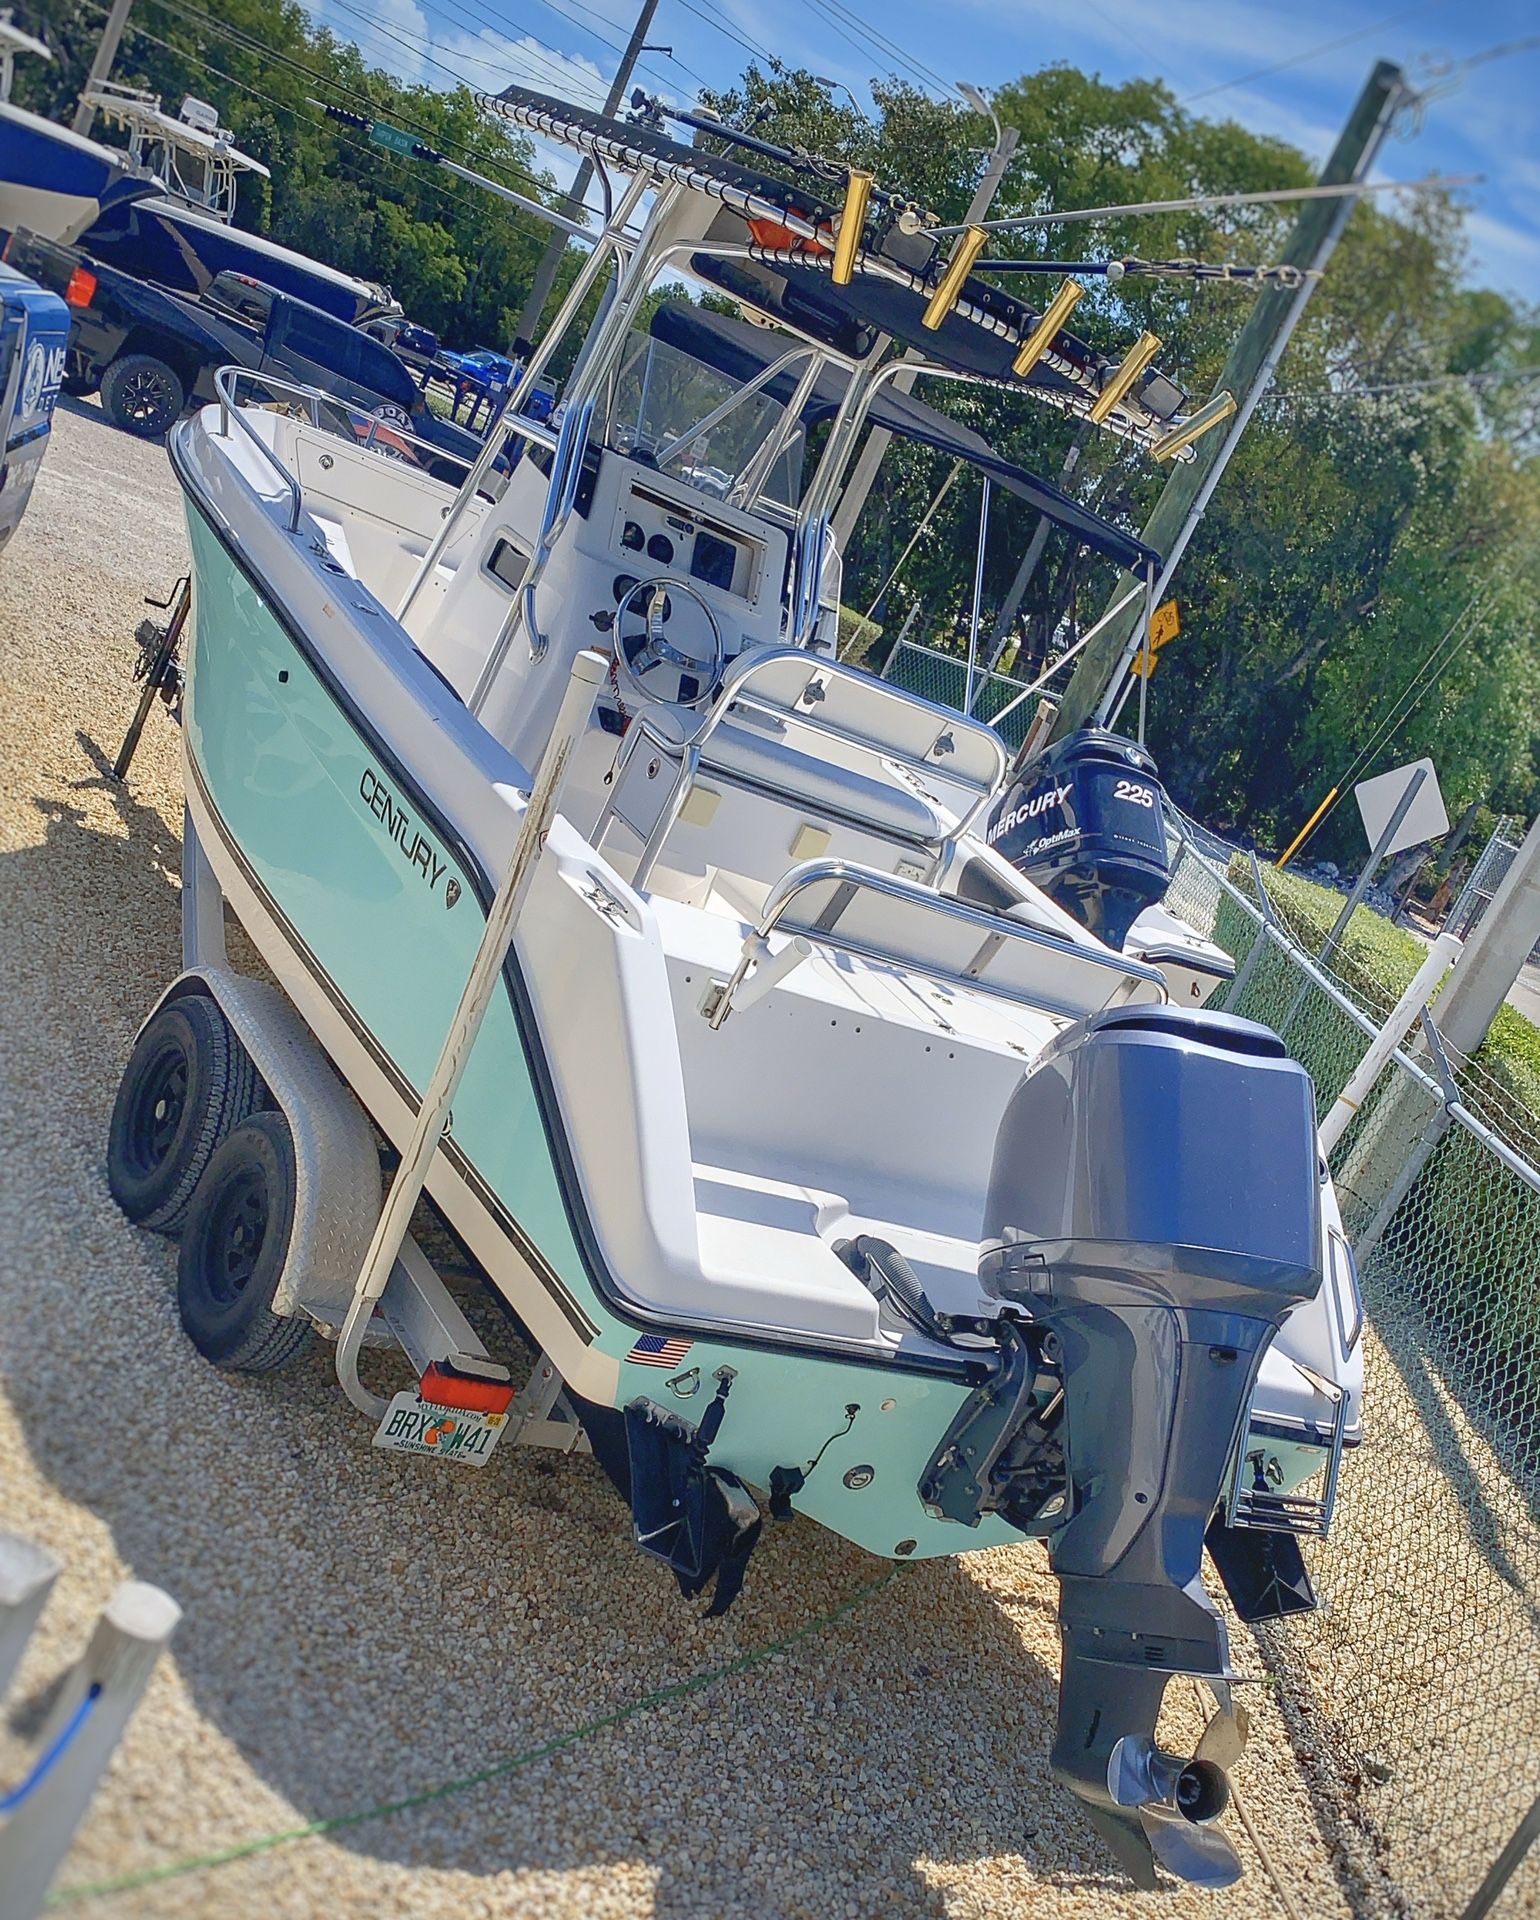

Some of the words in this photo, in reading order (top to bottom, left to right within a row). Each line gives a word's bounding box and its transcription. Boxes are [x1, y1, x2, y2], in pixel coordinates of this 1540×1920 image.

[1113, 780, 1153, 808] 225
[360, 767, 447, 889] CENTURY
[987, 783, 1075, 845] MERCURY
[1037, 826, 1082, 850] OptiMax
[384, 1409, 434, 1442] BRX
[449, 1422, 493, 1454] W41
[399, 1439, 438, 1454] SUNSHINE
[439, 1448, 463, 1459] STATE
